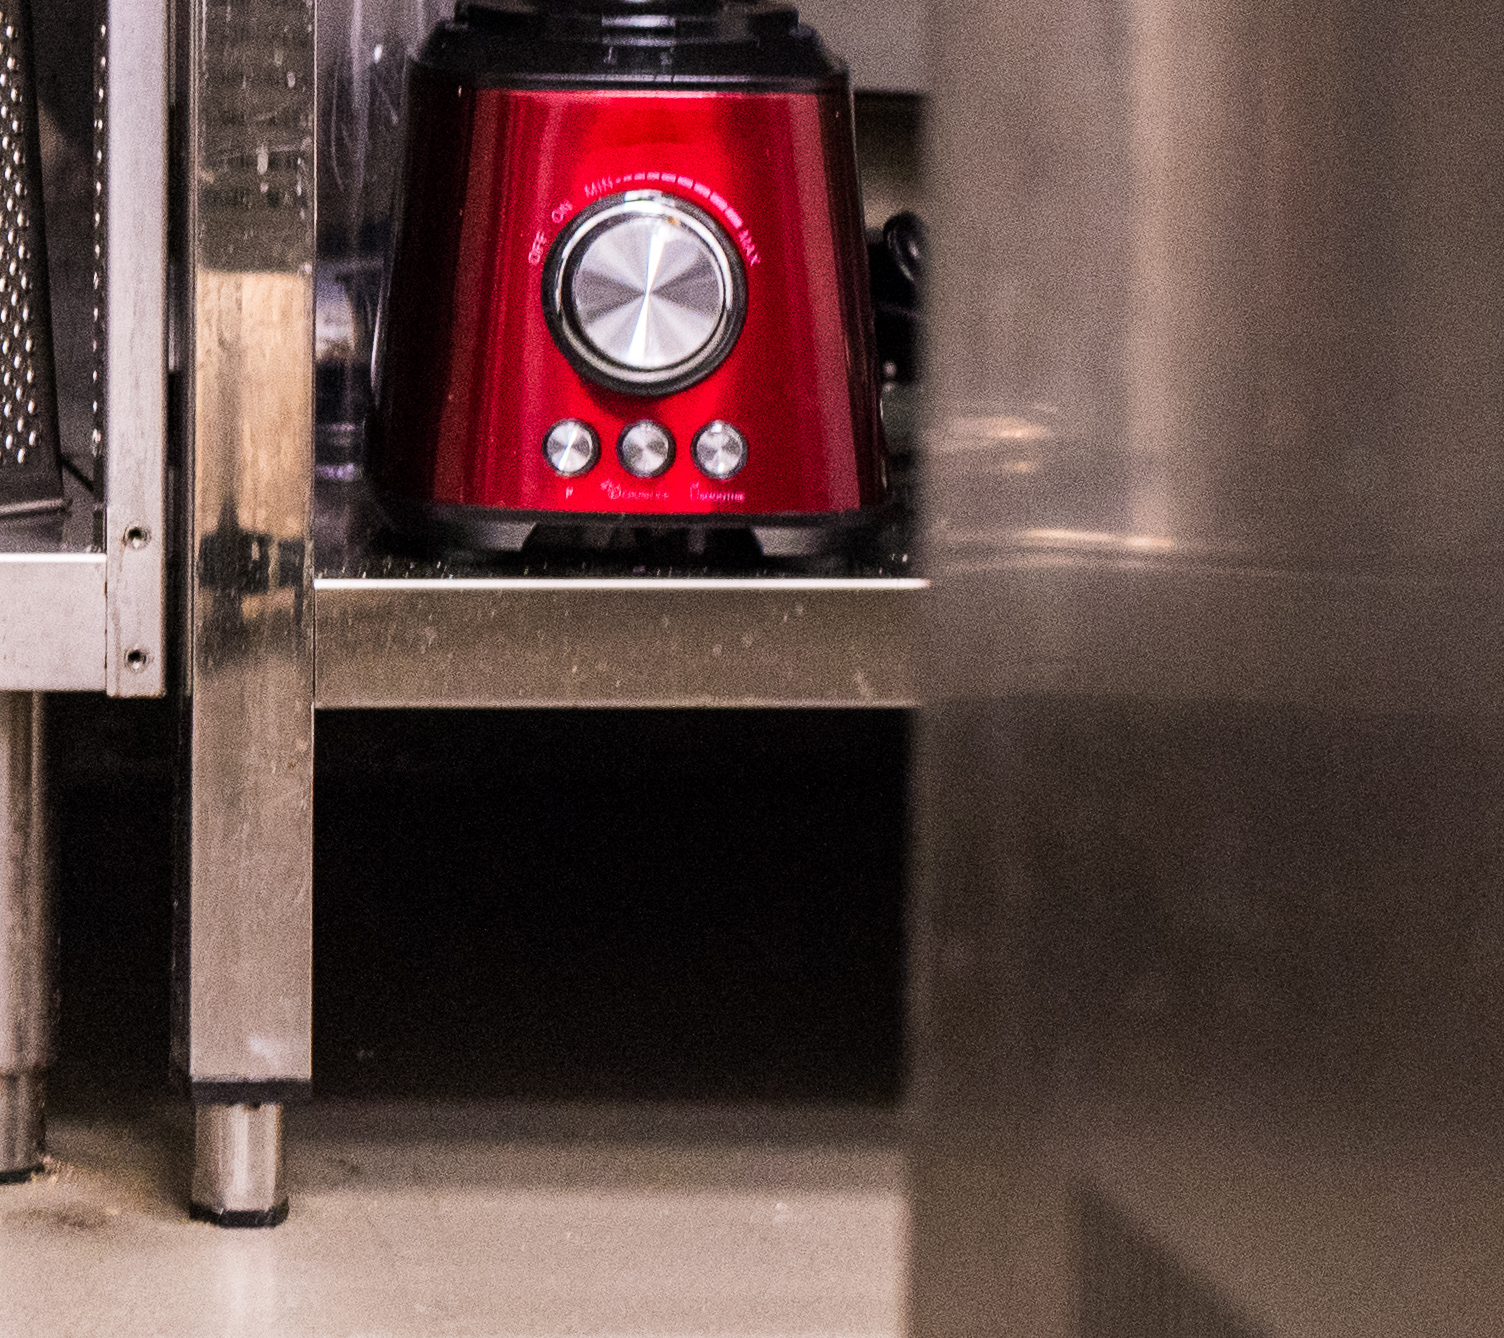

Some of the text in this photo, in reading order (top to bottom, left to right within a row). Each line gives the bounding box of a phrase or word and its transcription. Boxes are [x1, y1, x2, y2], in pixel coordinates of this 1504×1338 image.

[584, 176, 614, 199] MIN
[551, 200, 573, 223] ON
[528, 230, 548, 266] OFF
[739, 230, 761, 266] MAX
